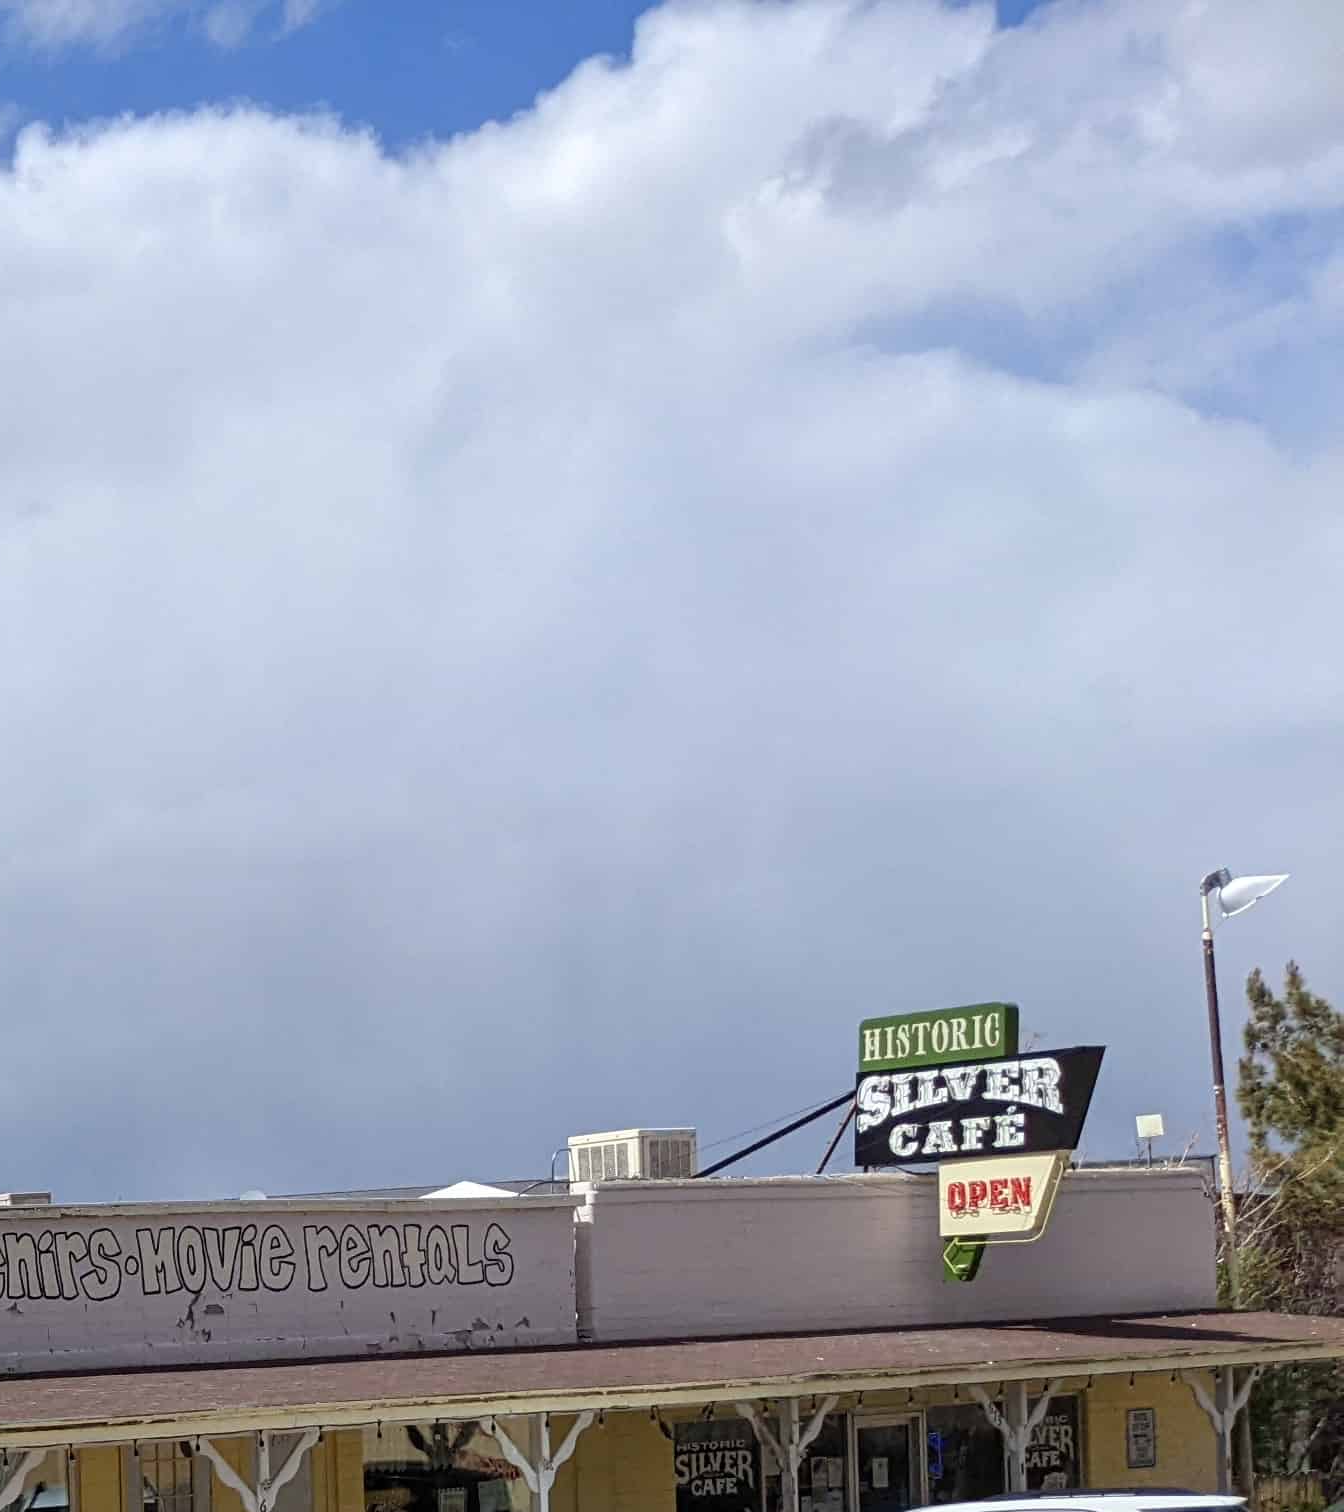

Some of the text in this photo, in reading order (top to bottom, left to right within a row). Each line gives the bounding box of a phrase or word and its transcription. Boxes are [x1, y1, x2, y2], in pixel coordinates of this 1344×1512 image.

[863, 1012, 1000, 1062] HISTORIC
[857, 1057, 1064, 1133] SILVER
[888, 1105, 1025, 1157] CAFÉ
[947, 1176, 1032, 1214] OPEN
[676, 1439, 745, 1451] HISTORIC
[675, 1450, 754, 1488] SILVER
[691, 1477, 738, 1496] CAFE
